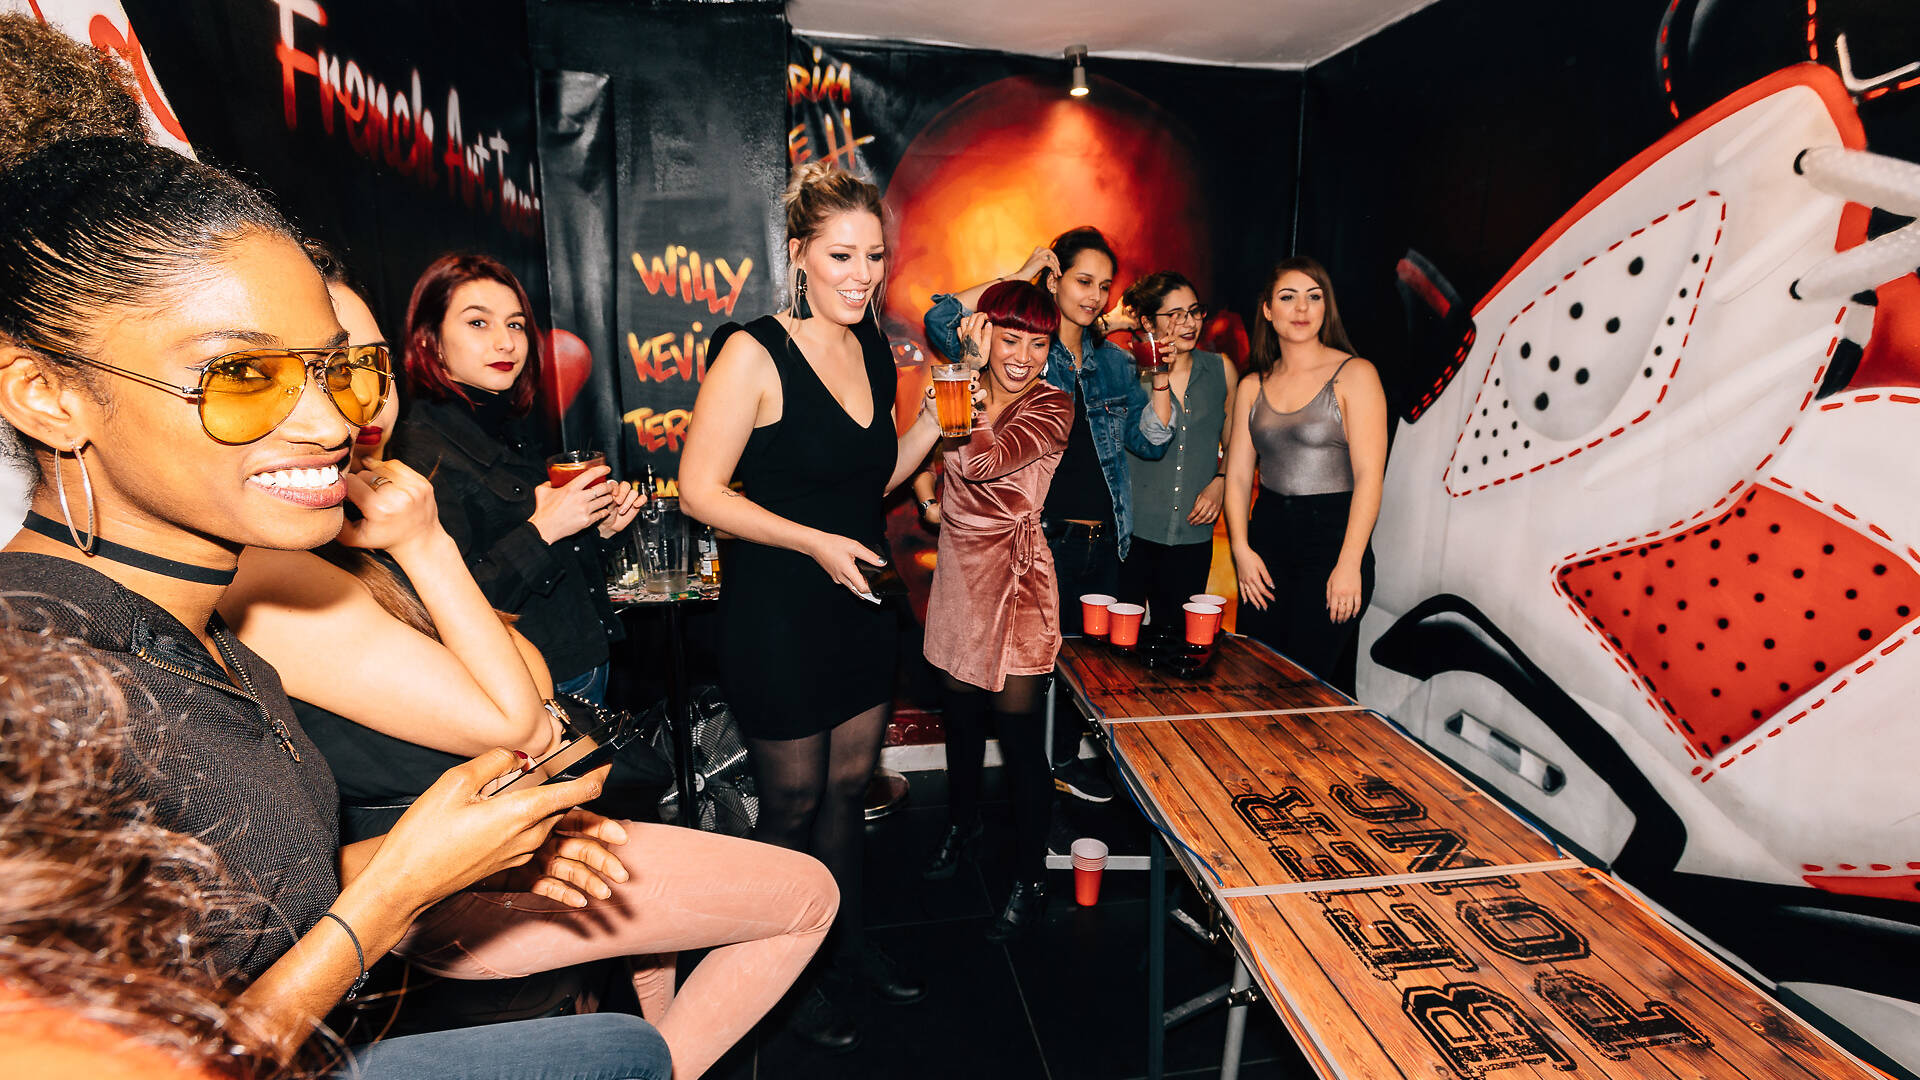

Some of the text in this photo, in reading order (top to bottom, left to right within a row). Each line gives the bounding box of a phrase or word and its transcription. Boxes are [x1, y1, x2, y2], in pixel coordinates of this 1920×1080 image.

[623, 407, 694, 452] TER
[627, 320, 711, 384] KEVi
[1231, 785, 1578, 1080] BEER
[1329, 771, 1716, 1062] PONG
